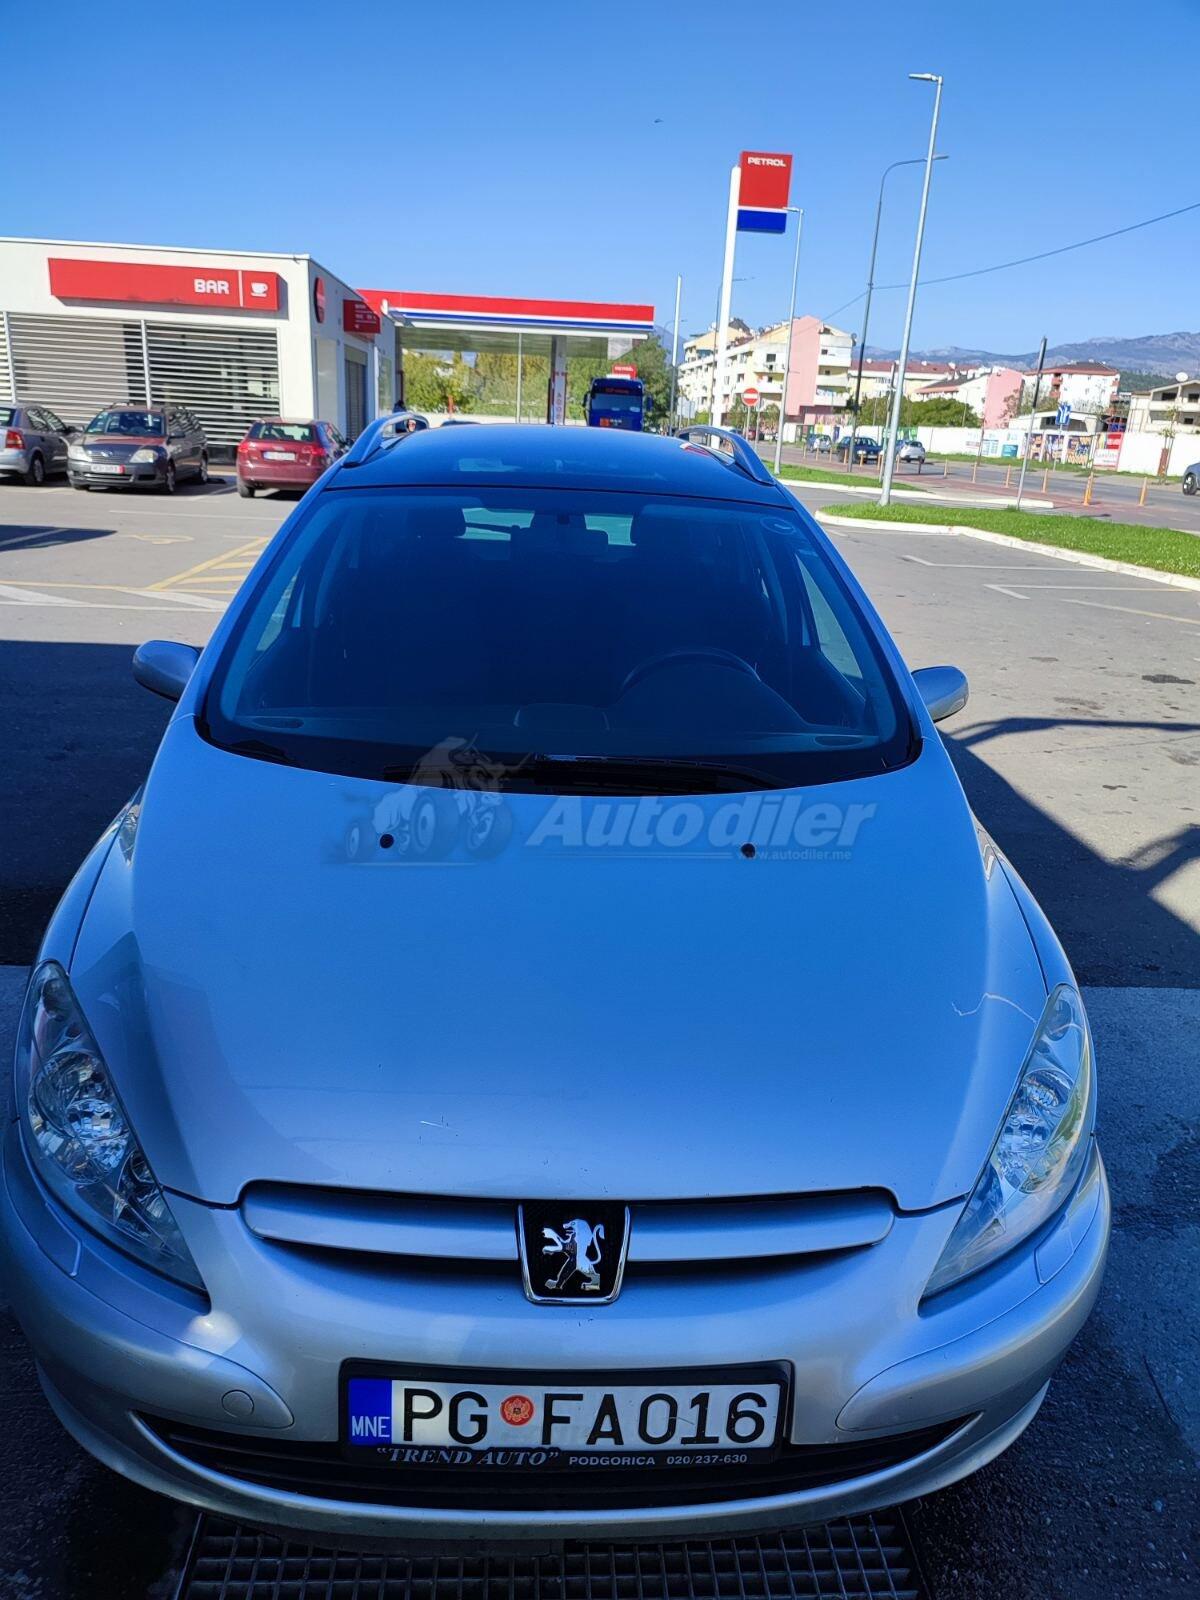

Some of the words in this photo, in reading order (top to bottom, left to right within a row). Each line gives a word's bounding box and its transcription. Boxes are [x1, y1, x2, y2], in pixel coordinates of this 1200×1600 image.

[747, 156, 787, 167] PETROL
[194, 278, 230, 295] BAR
[403, 1387, 489, 1445] PG
[351, 1415, 391, 1439] MNE
[569, 1456, 656, 1466] PODGORICA
[666, 1454, 748, 1465] 020/237-630
